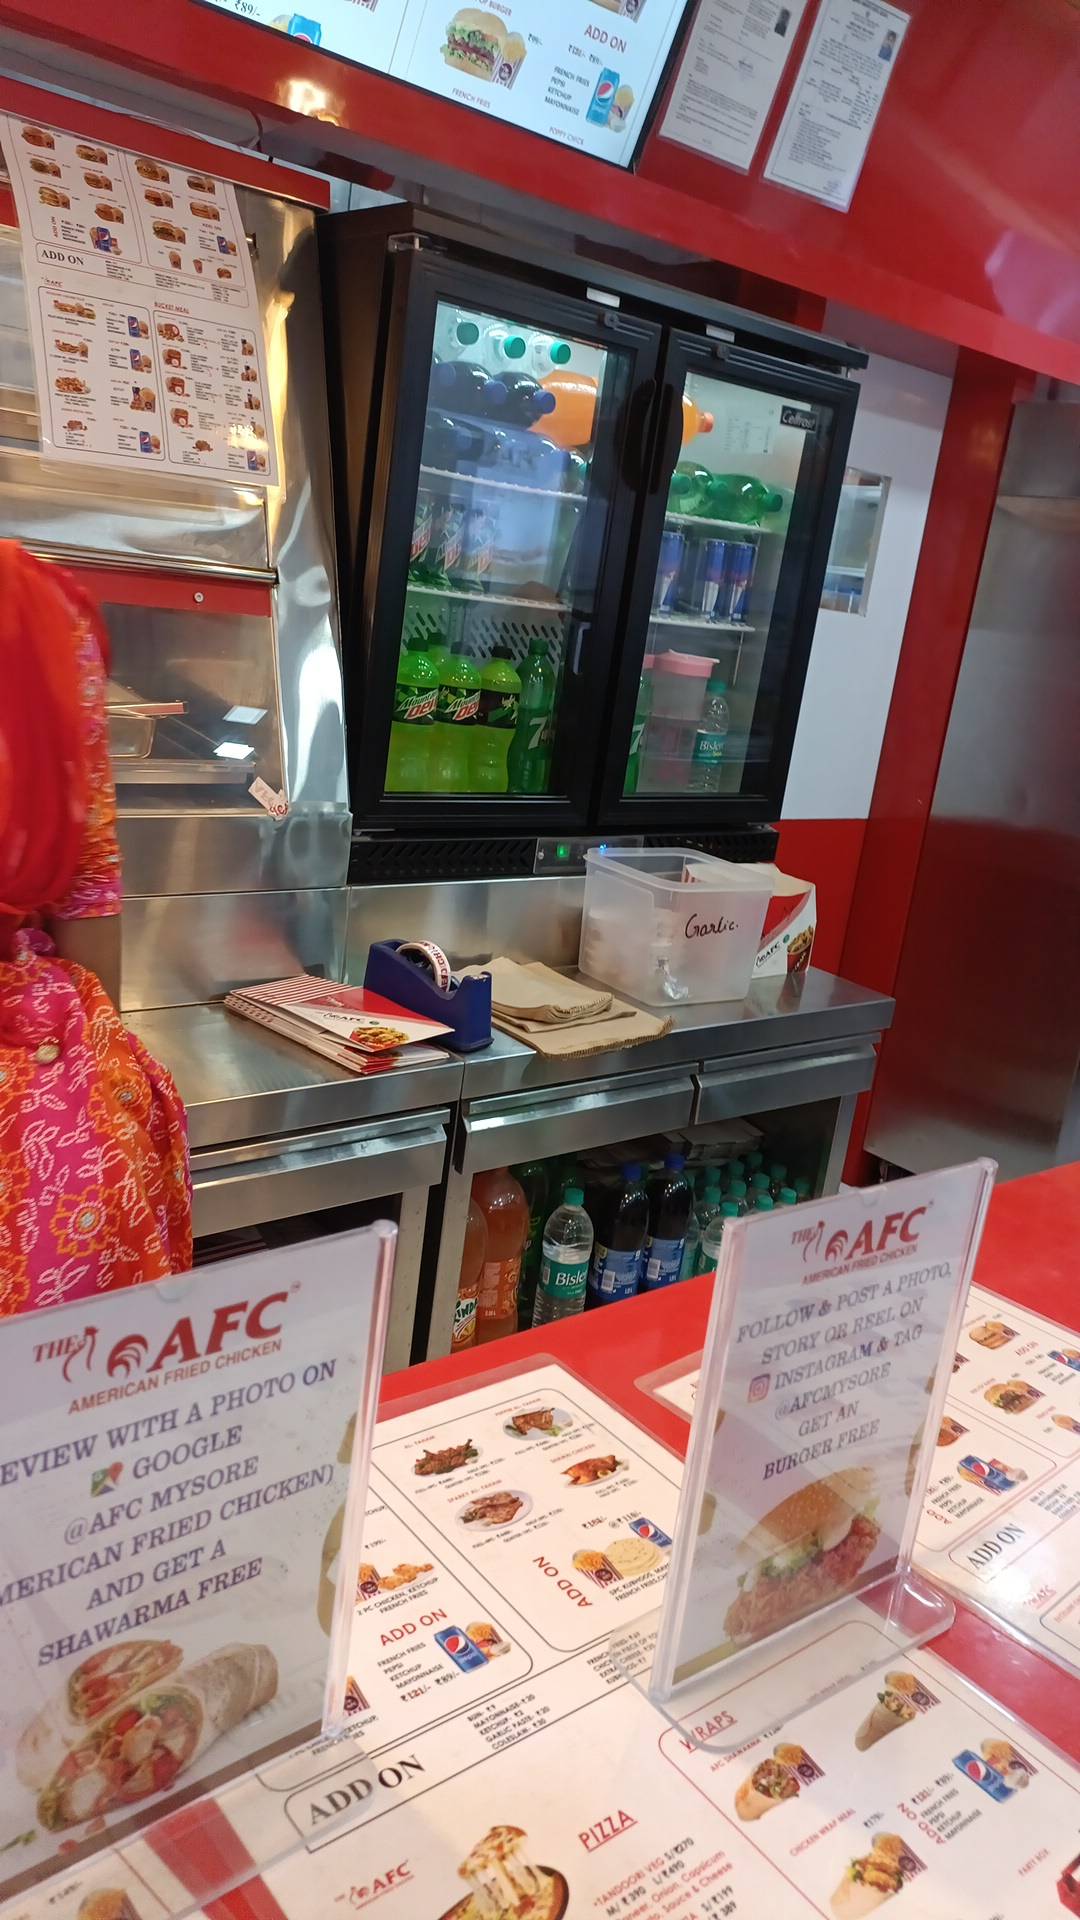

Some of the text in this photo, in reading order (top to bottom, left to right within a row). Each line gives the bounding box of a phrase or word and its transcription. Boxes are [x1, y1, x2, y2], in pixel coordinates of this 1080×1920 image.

[584, 24, 627, 54] ADD ON
[41, 249, 85, 265] ADD ON
[844, 1206, 927, 1261] AFC
[801, 1243, 918, 1286] AMERICAN FRIED CHICKEN
[33, 1292, 289, 1374] THE AFC
[736, 1302, 818, 1344] FOLLOW
[818, 1299, 833, 1316] &
[836, 1283, 880, 1312] POST
[883, 1280, 894, 1295] A
[761, 1297, 924, 1365] STORY OR REEL ON
[67, 1339, 283, 1416] AMERICAN FRIED CHICKEN
[774, 1324, 923, 1391] INSTAGRAM & TAG
[774, 1361, 891, 1421] @AFCMYSORE
[0, 1359, 338, 1487] EVIEW WITH A PHOTO ON
[798, 1401, 860, 1438] GET AN
[132, 1425, 243, 1480] GOOGLE
[762, 1419, 880, 1481] BURGER FREE
[63, 1456, 259, 1547] @AFC MYSORE
[130, 1510, 213, 1557] FRIED
[219, 1463, 335, 1521] CHICKEN)
[966, 1523, 1026, 1570] ADD ON
[86, 1539, 227, 1611] AND GET A
[532, 1555, 593, 1610] ADD ON
[38, 1557, 264, 1667] SHAWARMA FREE
[379, 1590, 428, 1614] FRENCH FRIES
[379, 1608, 448, 1646] ADD ON
[377, 1642, 426, 1667] FRENCH FRIES
[383, 1663, 404, 1674] PEPSI
[390, 1663, 422, 1682] KETCHUP
[396, 1664, 444, 1689] MAYONNAISE
[308, 1754, 426, 1825] ADD ON
[920, 1788, 959, 1818] FRENCH FRIES
[578, 1810, 635, 1850] PIZZA
[789, 1832, 820, 1857] CHICKEN
[837, 1808, 857, 1822] MEAL
[373, 1862, 413, 1893] AFC
[645, 1857, 665, 1873] VEG
[662, 1891, 692, 1913] Sauce
[698, 1862, 733, 1887] Cheese
[680, 1850, 726, 1882] Capsicum
